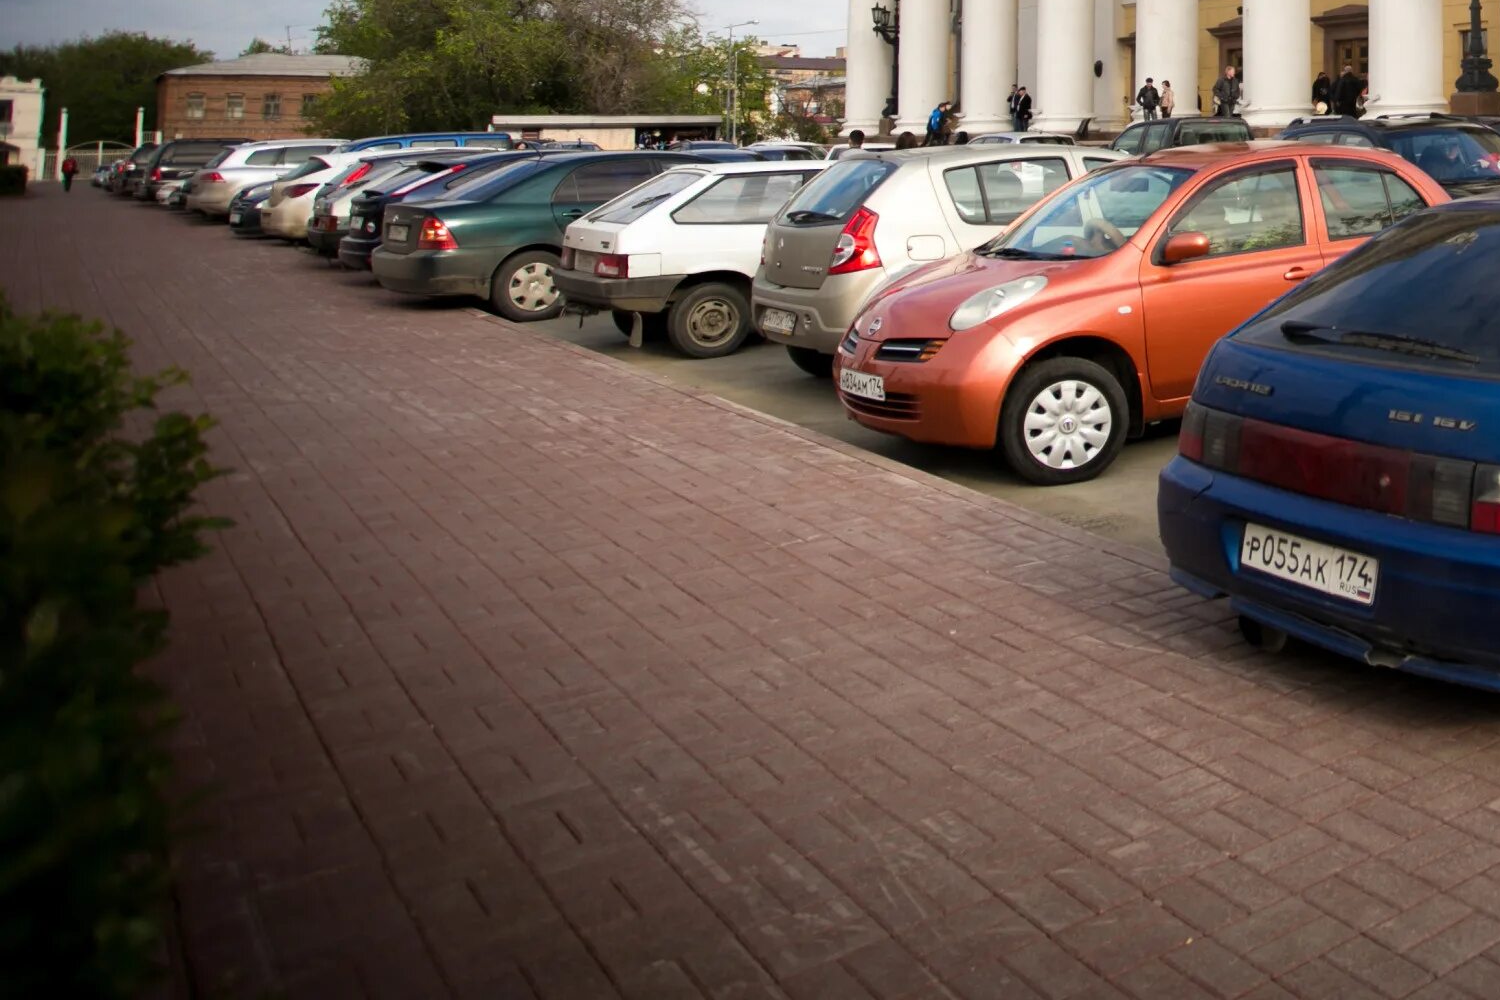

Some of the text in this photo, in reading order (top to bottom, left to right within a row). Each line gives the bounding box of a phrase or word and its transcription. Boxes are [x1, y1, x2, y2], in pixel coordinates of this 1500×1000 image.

[1249, 534, 1369, 587] Р055АК 174
[1340, 582, 1358, 595] RUS
